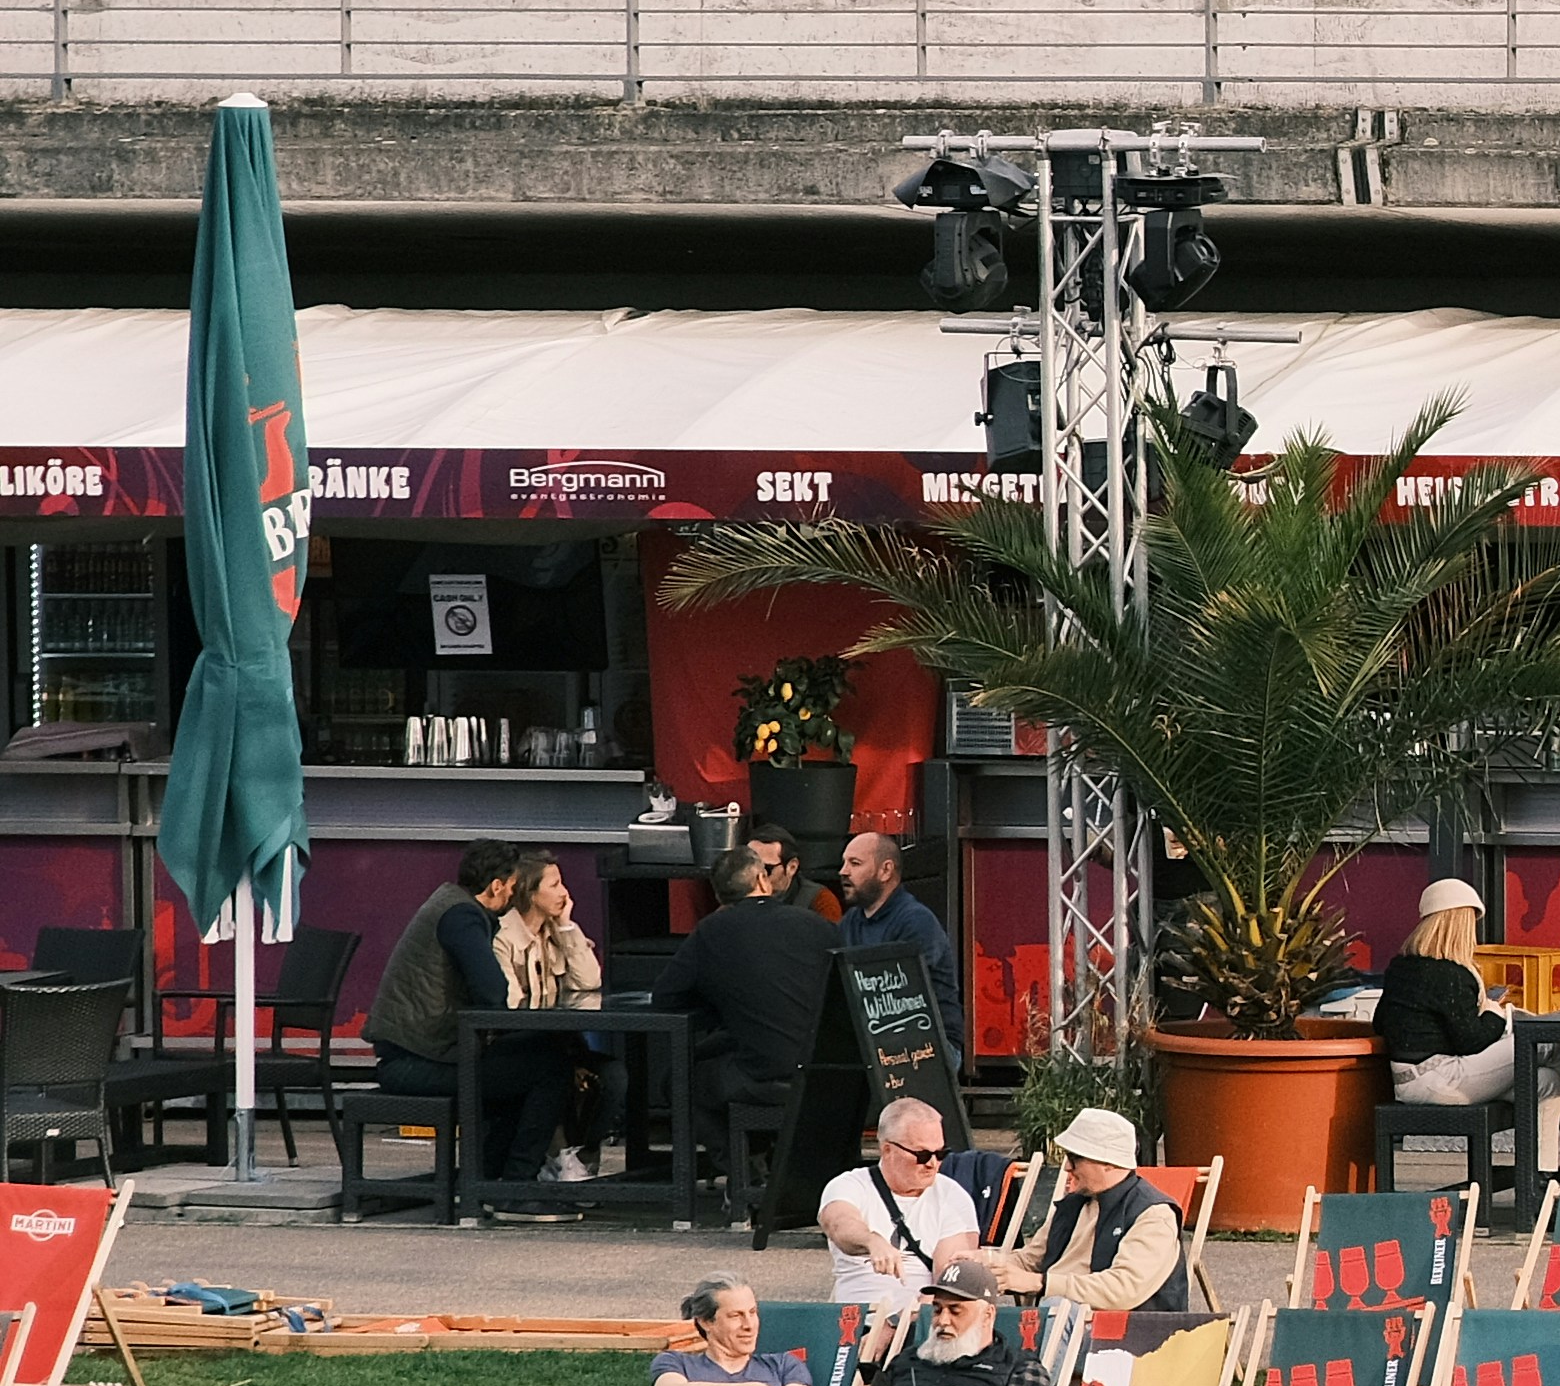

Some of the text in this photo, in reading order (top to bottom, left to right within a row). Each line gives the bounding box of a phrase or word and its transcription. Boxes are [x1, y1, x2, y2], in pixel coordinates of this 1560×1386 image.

[0, 458, 103, 496] LIKÖRE
[306, 458, 411, 499] RÄNKE
[509, 468, 665, 492] Bergmann
[756, 472, 832, 502] SEKT
[922, 473, 1067, 503] MIXGET
[14, 1216, 72, 1232] MARTINI
[1430, 1238, 1446, 1284] BERLINER
